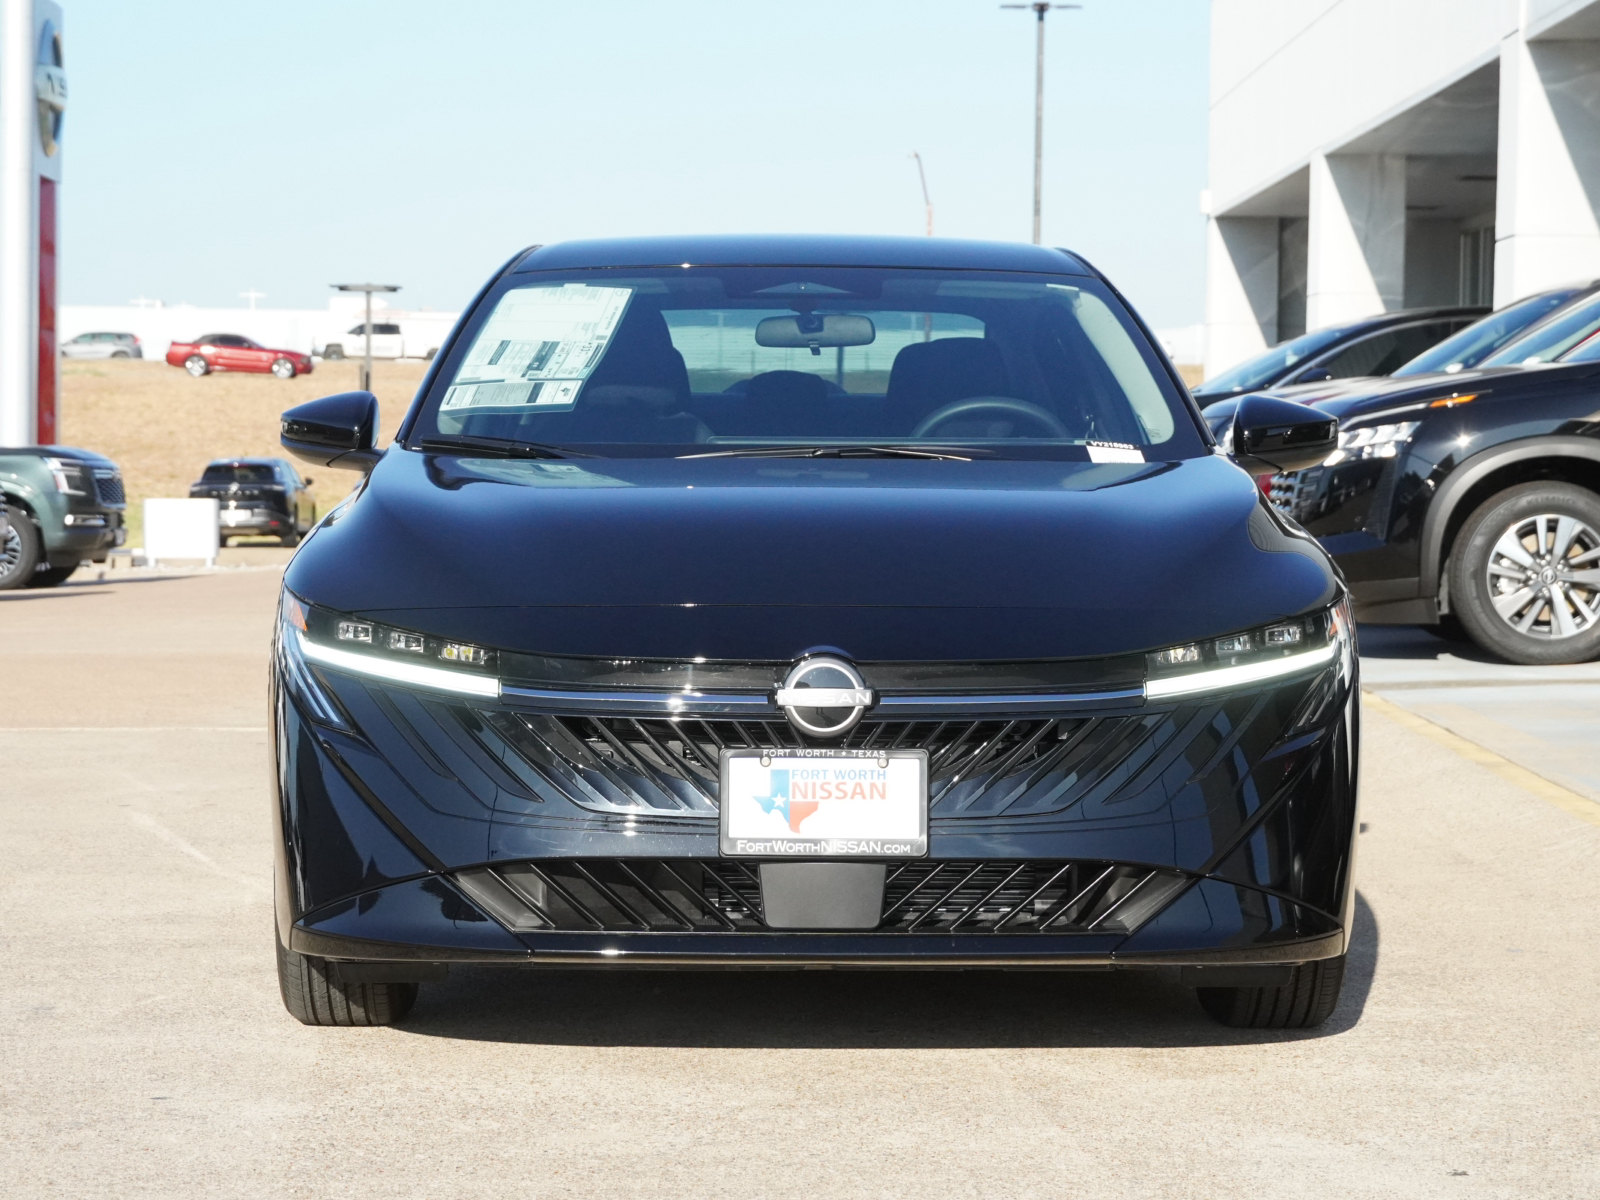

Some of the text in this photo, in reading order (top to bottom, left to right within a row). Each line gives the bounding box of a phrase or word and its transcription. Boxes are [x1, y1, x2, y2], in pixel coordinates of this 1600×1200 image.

[779, 692, 870, 704] NISSAN
[763, 750, 886, 758] FORT WORTH TEXAS
[791, 769, 886, 781] FORT WORTH
[791, 782, 886, 800] NISSAN
